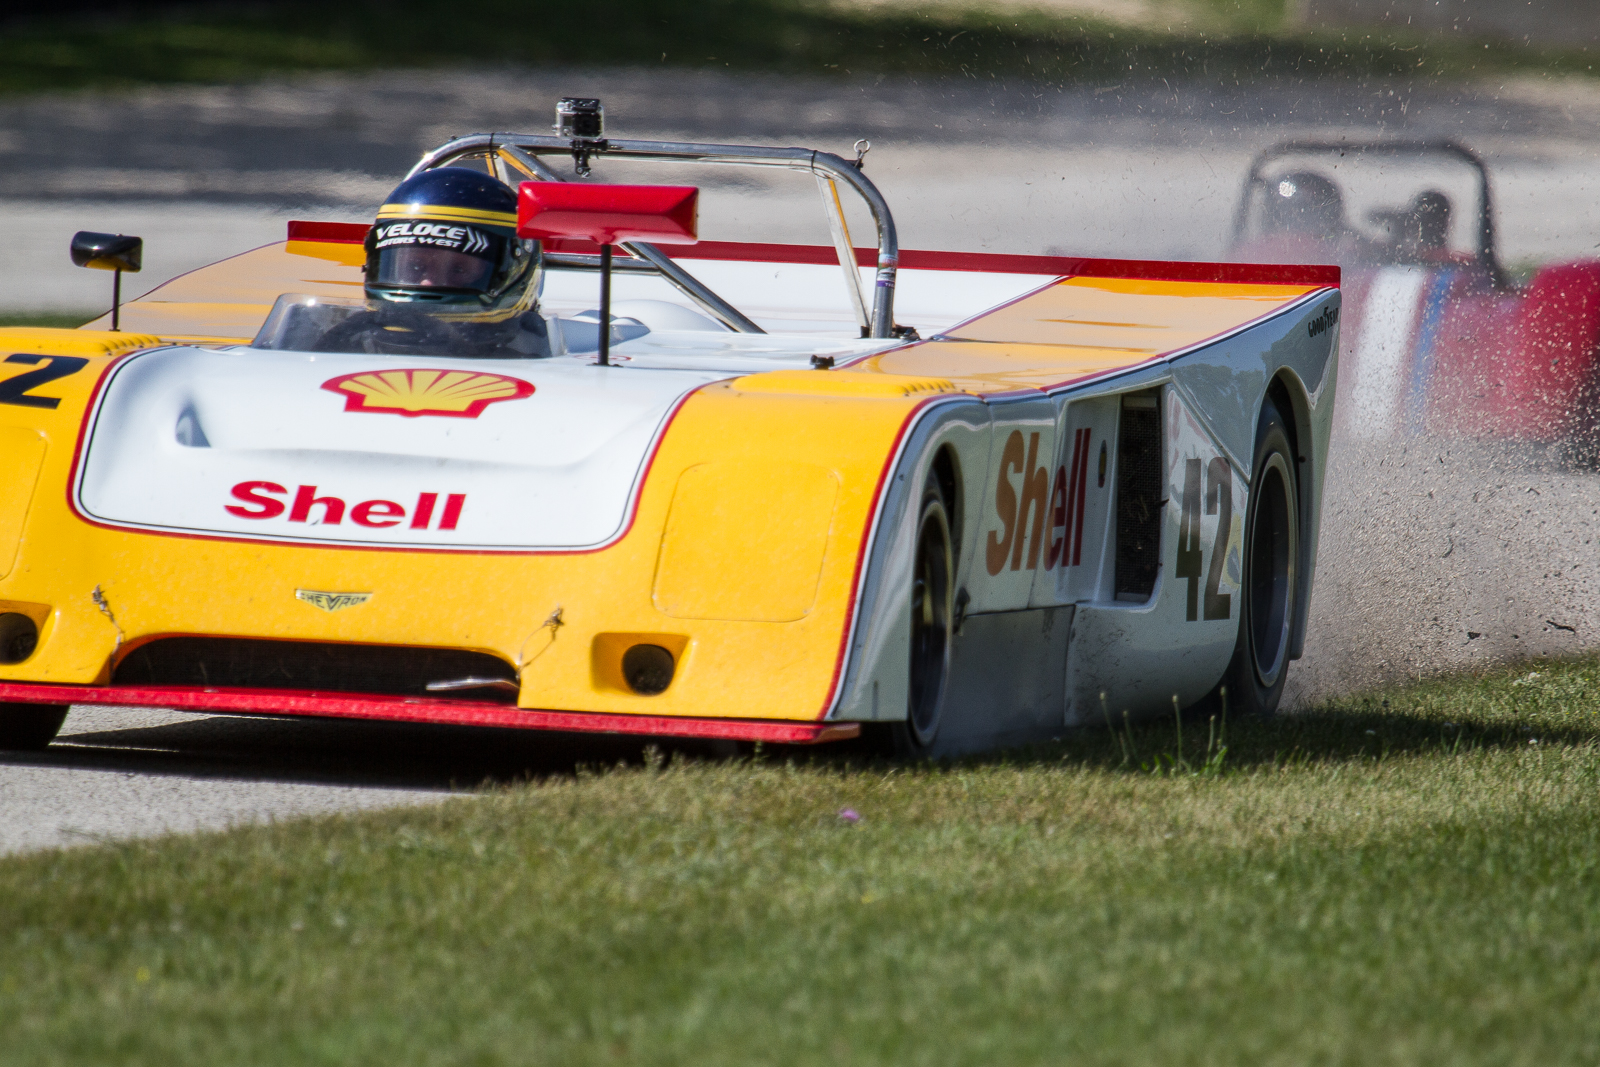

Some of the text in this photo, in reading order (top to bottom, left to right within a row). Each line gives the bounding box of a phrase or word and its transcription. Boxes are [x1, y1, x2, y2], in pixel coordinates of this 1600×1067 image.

[375, 237, 461, 249] MOTORS WEST
[376, 223, 466, 240] VELOCE
[224, 480, 467, 531] Shell
[984, 428, 1092, 577] Shell
[1175, 456, 1232, 622] 42
[298, 592, 367, 611] CHEVRON
